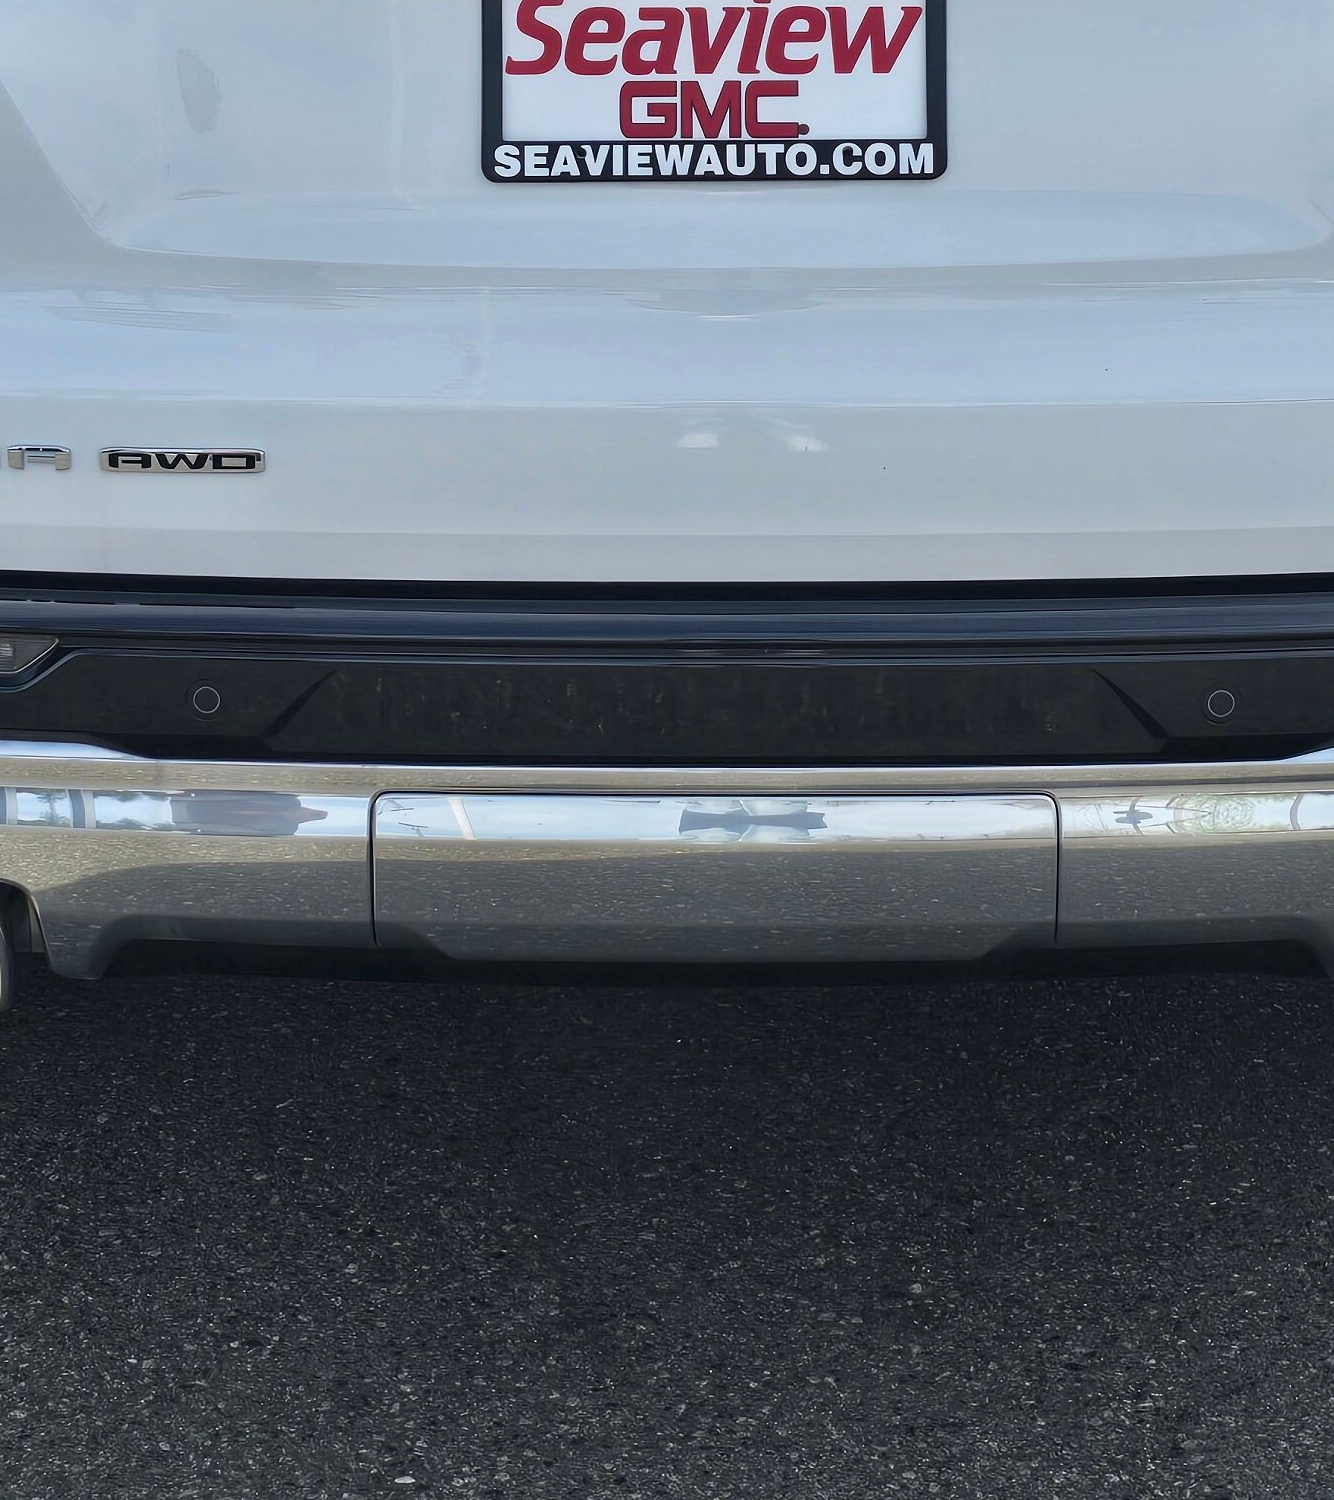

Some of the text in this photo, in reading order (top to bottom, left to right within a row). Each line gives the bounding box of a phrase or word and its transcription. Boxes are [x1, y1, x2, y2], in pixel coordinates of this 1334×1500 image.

[618, 79, 801, 139] GMC
[493, 141, 935, 178] SEAVIEWAUTO.COM
[104, 449, 261, 472] AWD
